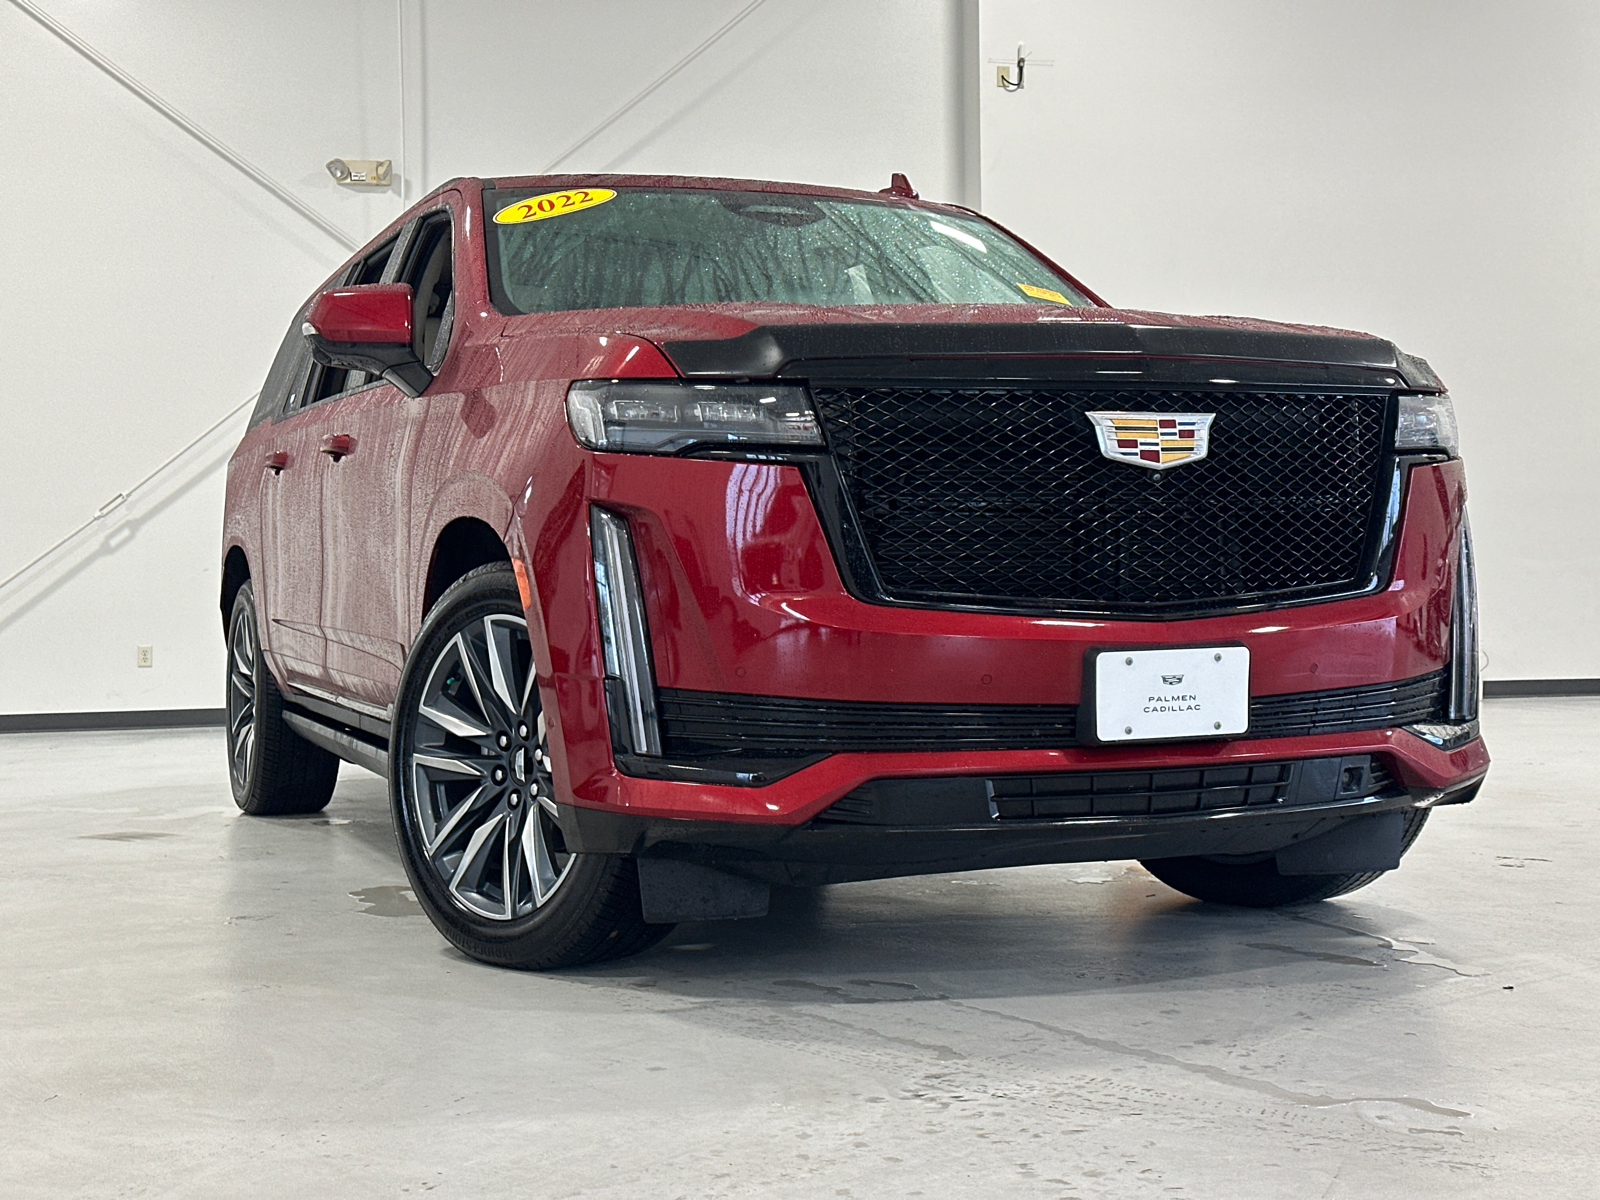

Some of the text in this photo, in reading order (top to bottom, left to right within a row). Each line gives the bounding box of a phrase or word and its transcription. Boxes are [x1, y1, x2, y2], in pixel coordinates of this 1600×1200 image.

[517, 191, 594, 219] 2022
[1148, 694, 1197, 703] PALMEN
[1143, 704, 1201, 713] CADILLAC
